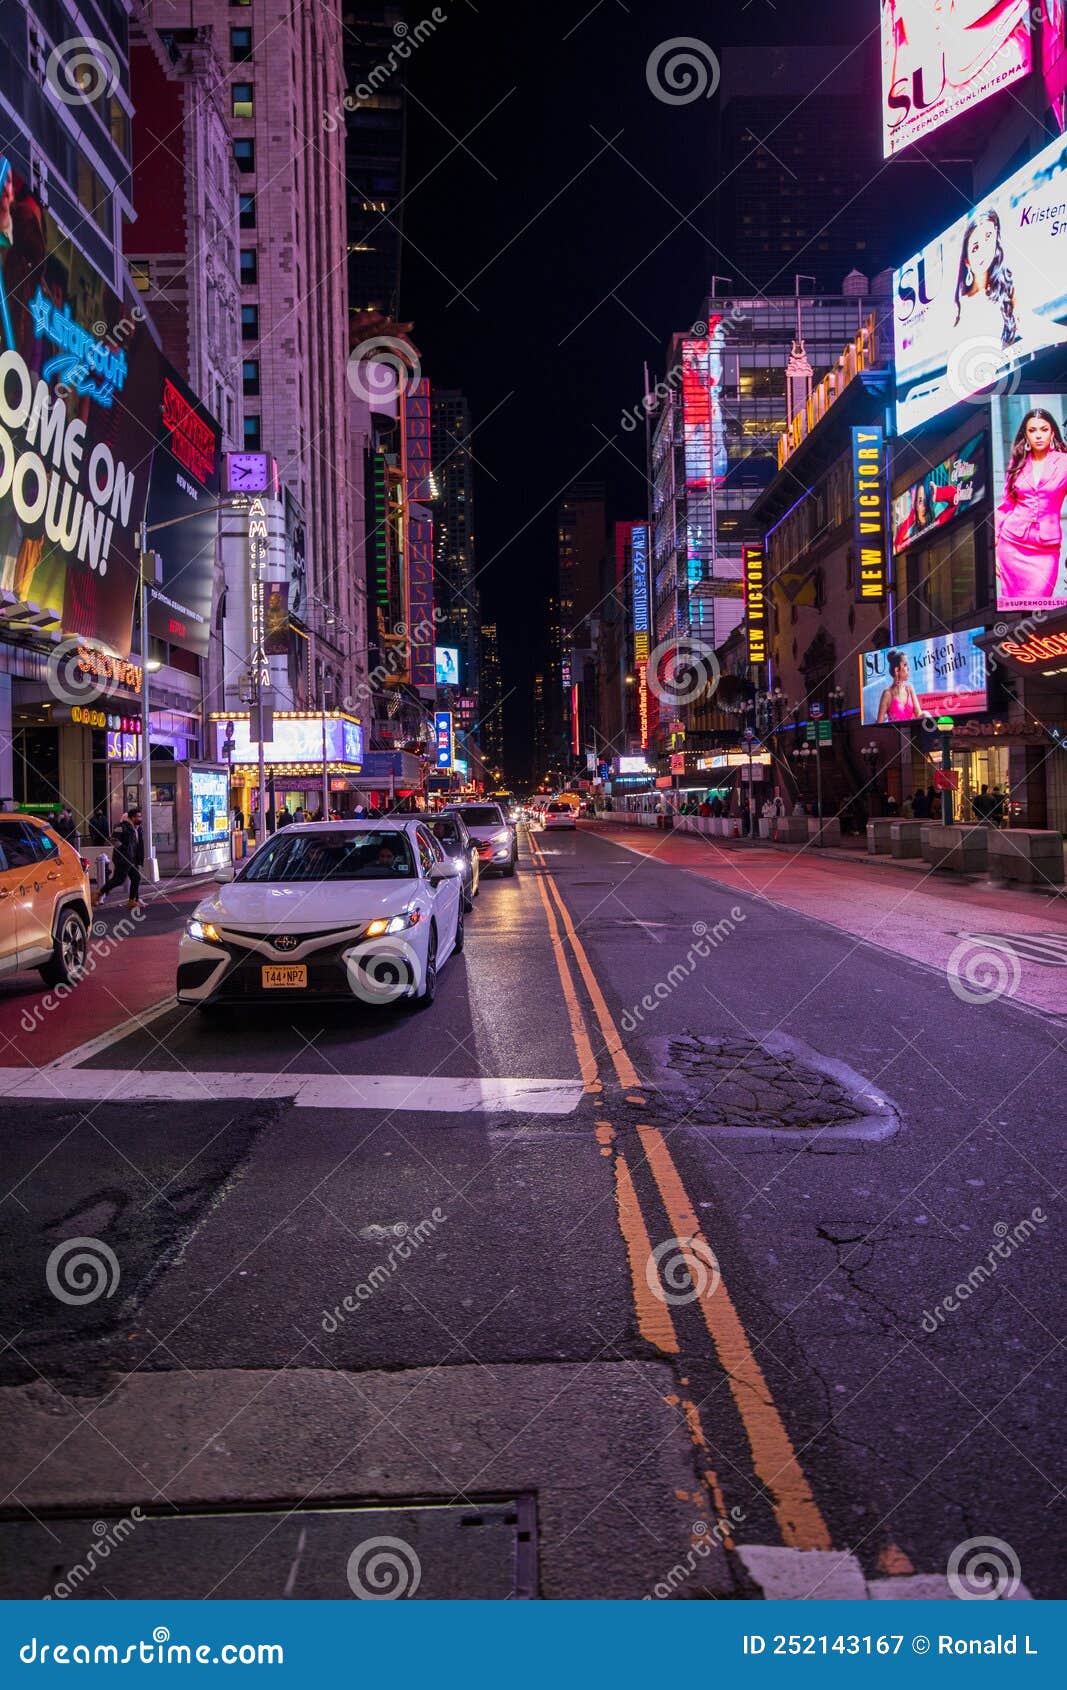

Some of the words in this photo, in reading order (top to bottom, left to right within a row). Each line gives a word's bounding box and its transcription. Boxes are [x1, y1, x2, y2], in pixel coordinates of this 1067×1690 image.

[887, 52, 946, 128] SU
[898, 243, 943, 321] SU
[409, 380, 429, 498] MADAME
[89, 443, 135, 527] ON
[857, 433, 881, 534] VICTORY
[632, 527, 646, 549] NEW
[747, 550, 764, 619] VICTORY
[861, 549, 883, 597] NEW
[634, 588, 648, 631] STUDIOS
[750, 626, 764, 662] NEW
[865, 651, 885, 677] SU
[913, 643, 955, 671] Kristen
[935, 653, 967, 679] Smith
[77, 644, 143, 693] Subway
